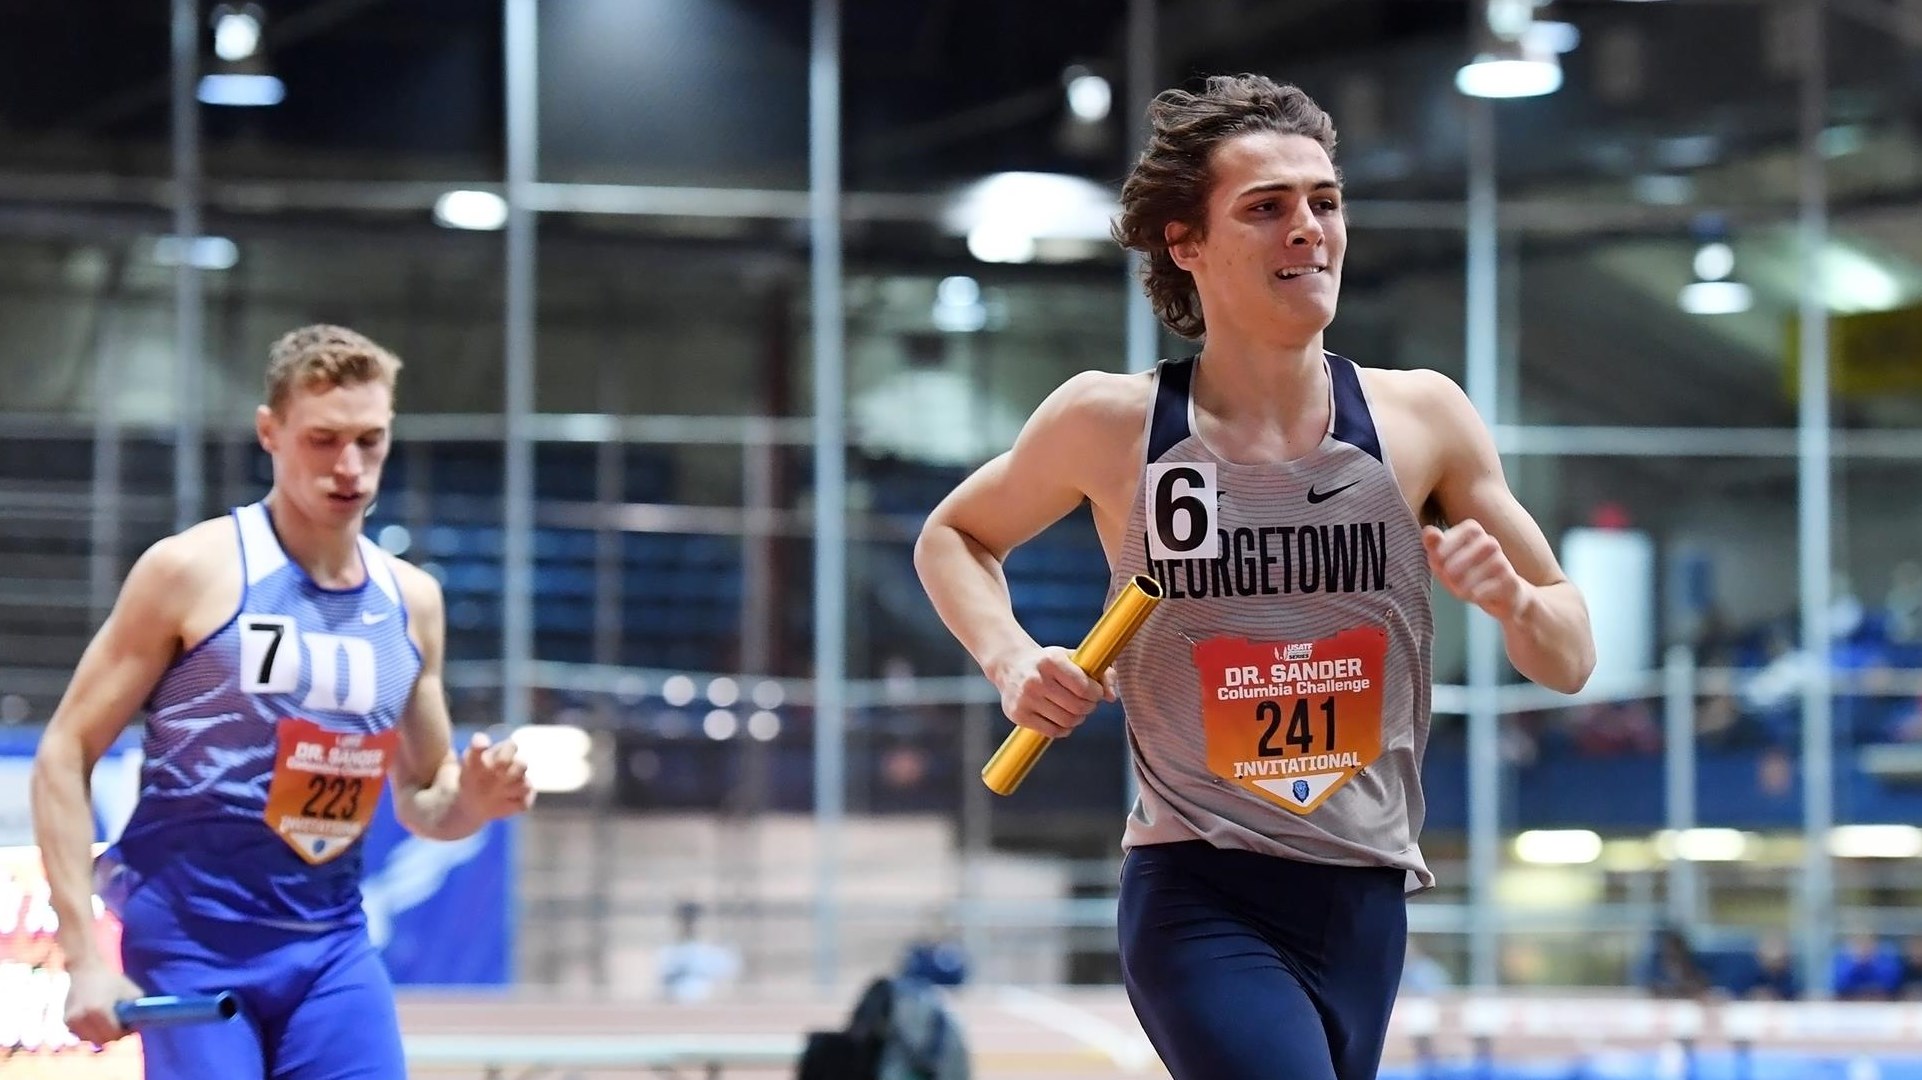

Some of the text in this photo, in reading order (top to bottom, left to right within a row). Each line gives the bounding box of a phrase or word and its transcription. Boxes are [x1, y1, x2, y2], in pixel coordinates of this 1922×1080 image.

[1155, 467, 1208, 552] 6
[249, 623, 285, 684] 7
[1286, 642, 1313, 652] USATF
[1217, 678, 1370, 701] Columbia Challenge
[1225, 658, 1363, 687] DR. SANDER
[1256, 695, 1336, 758] 241
[1233, 751, 1362, 779] INVITATIONAL
[301, 774, 362, 820] 223
